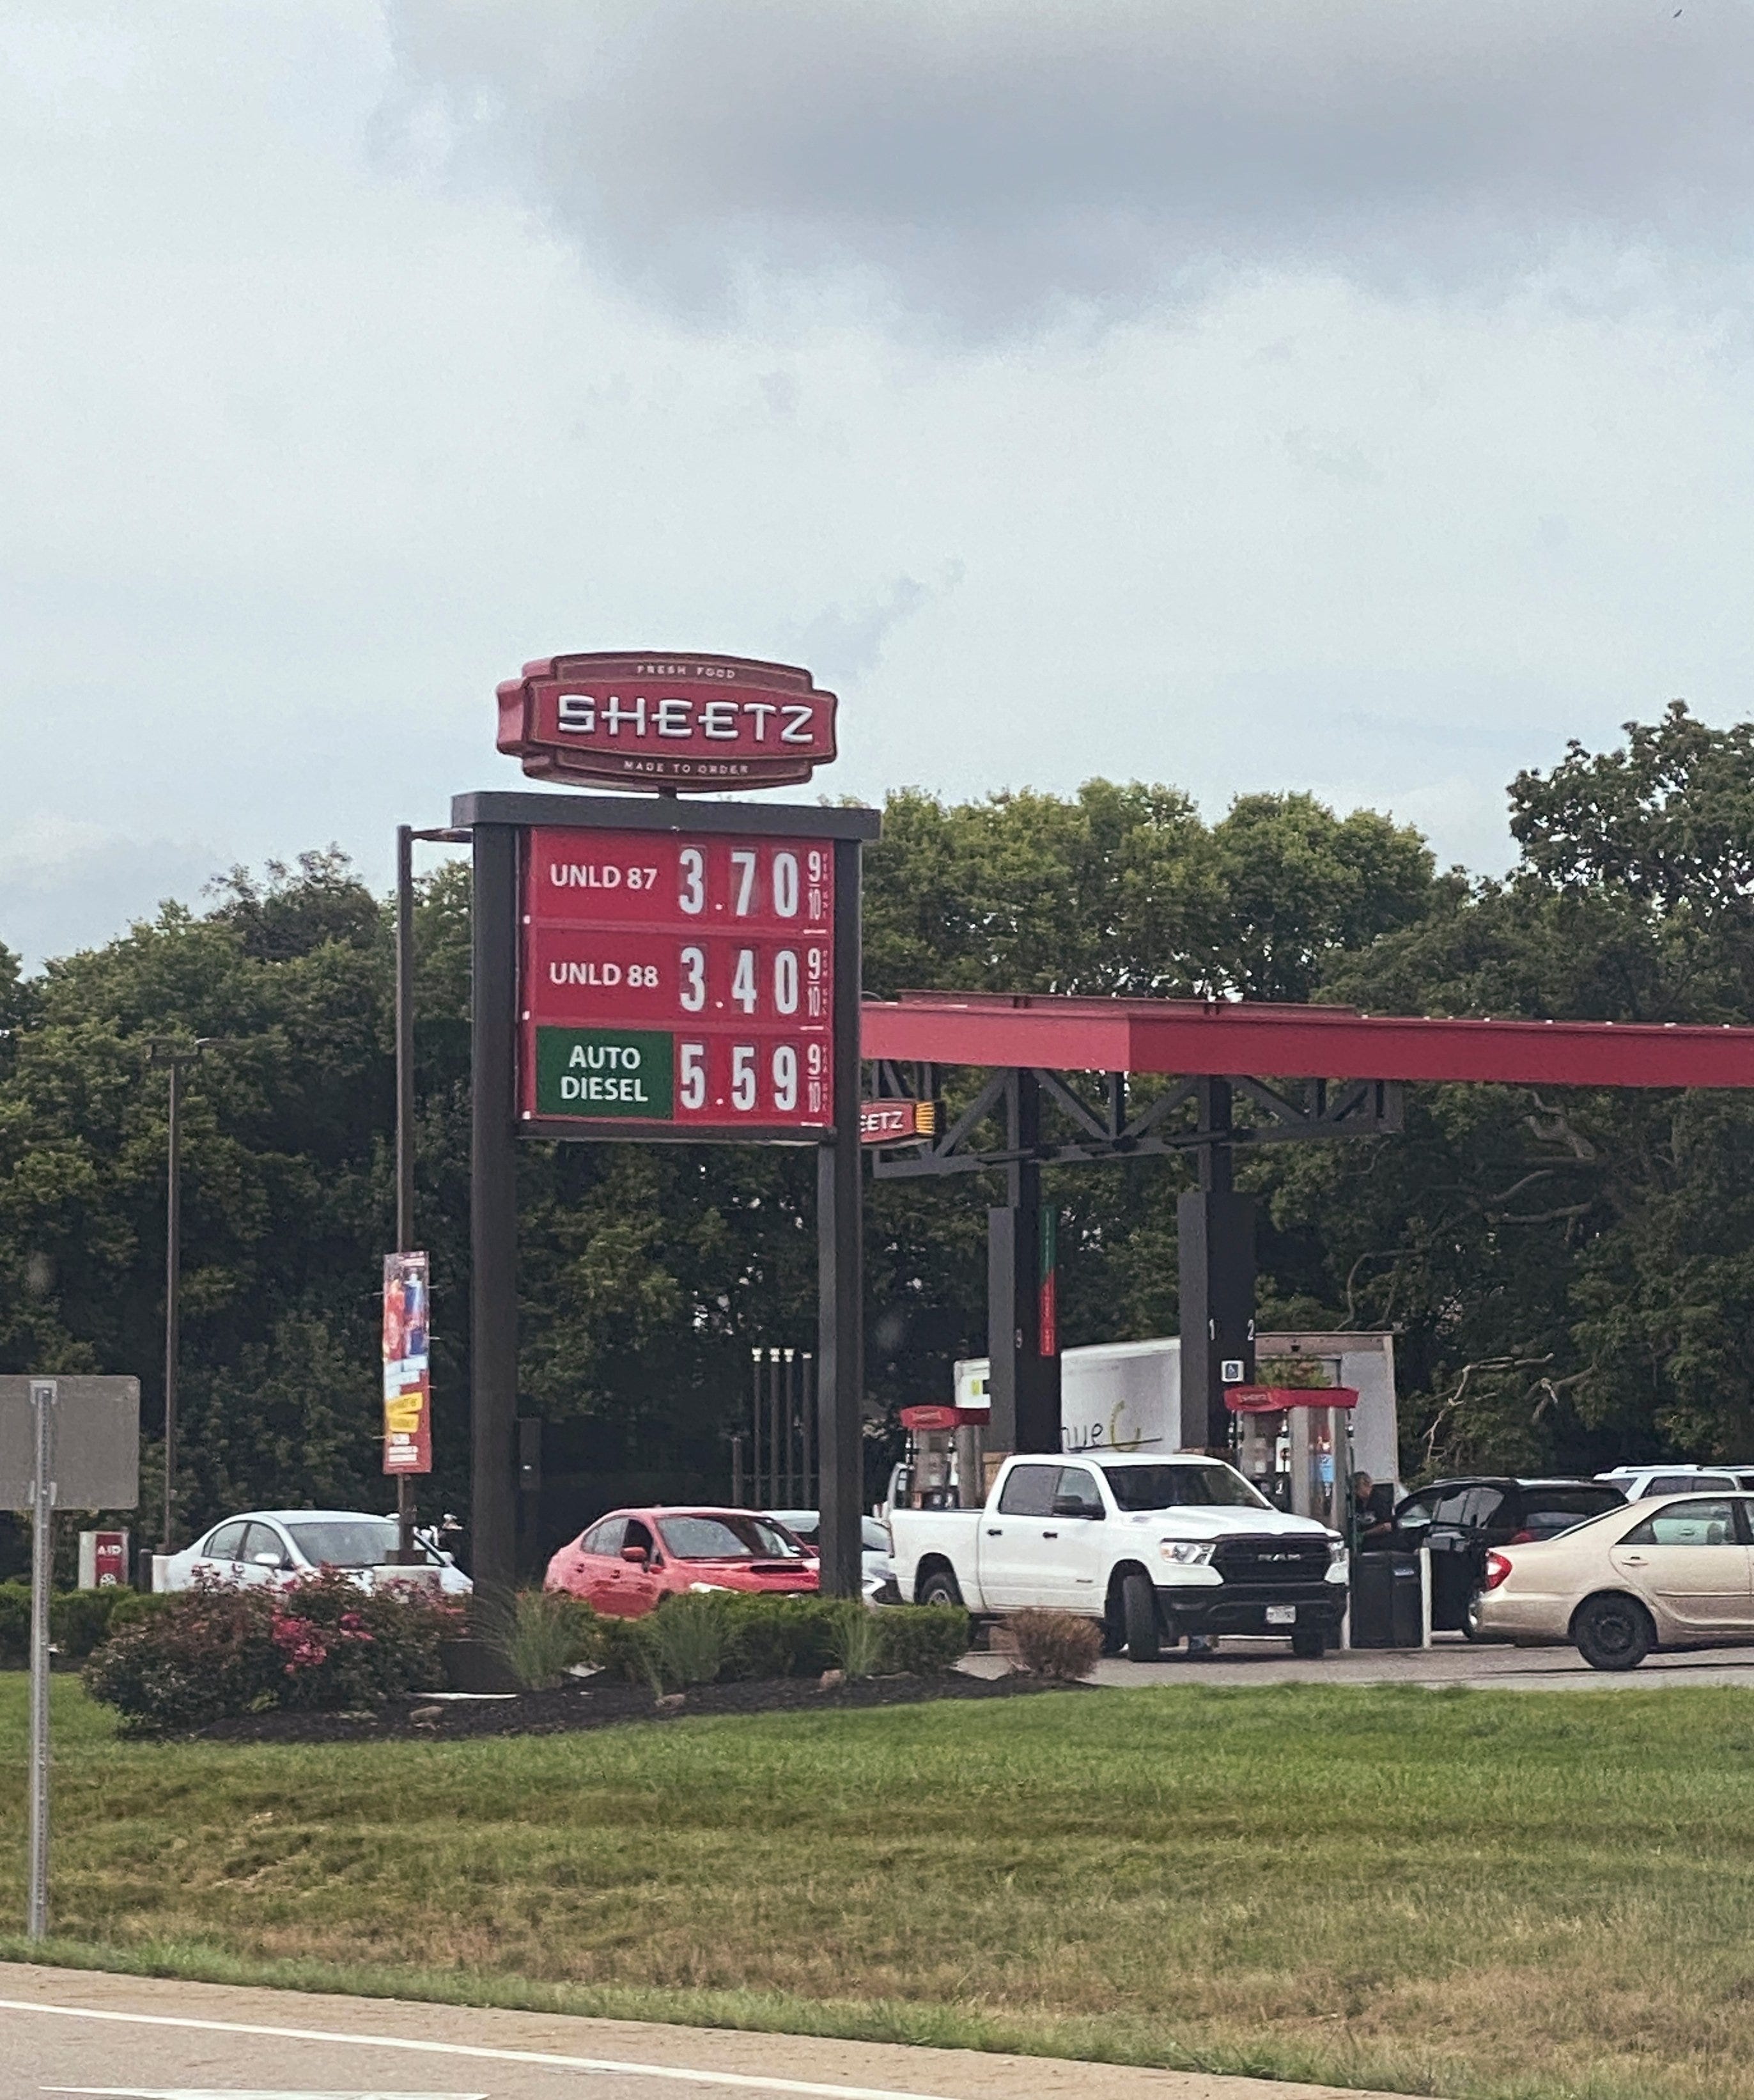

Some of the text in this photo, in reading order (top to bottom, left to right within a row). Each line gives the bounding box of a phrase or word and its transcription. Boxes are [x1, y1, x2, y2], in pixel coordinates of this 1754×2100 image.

[637, 665, 735, 679] FRESH FOOD
[558, 694, 813, 744] SHEETZ
[624, 761, 749, 775] MADE TO ORDER
[550, 864, 621, 888] UNLD
[627, 867, 657, 889] 87
[550, 962, 621, 985] UNLD
[627, 965, 659, 987] 88
[569, 1045, 640, 1069] AUTO
[561, 1076, 648, 1102] DIESEL
[1247, 1319, 1255, 1341] 2
